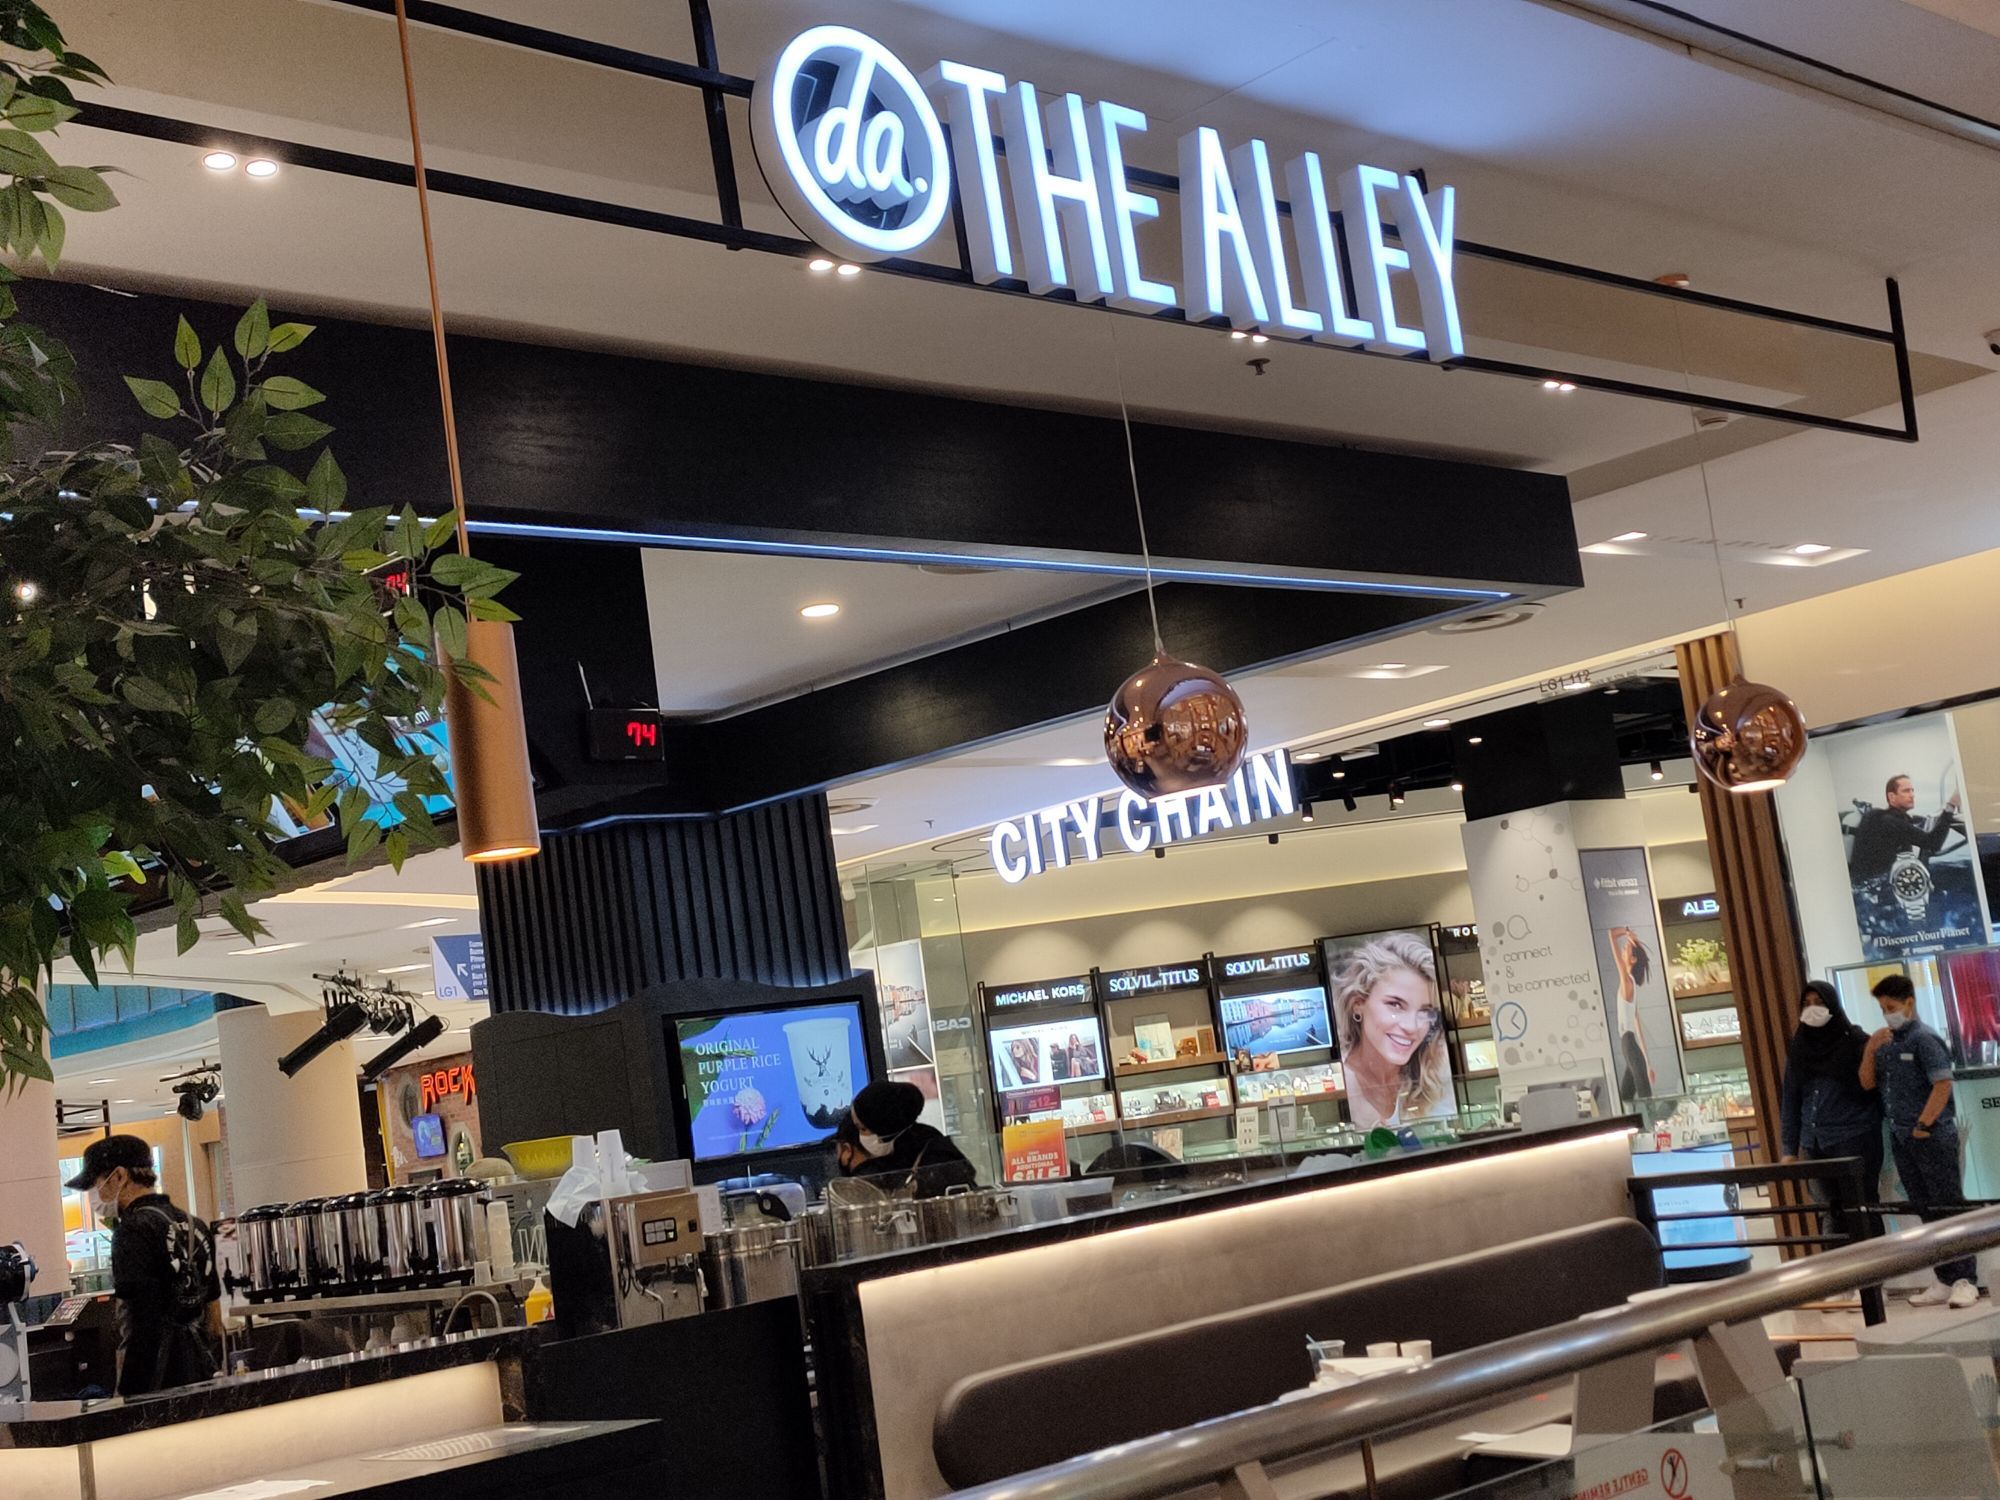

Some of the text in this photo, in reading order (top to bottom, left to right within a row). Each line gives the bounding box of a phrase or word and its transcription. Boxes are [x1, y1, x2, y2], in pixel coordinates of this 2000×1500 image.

[940, 60, 1464, 359] THE ALLEY
[627, 722, 656, 747] 74
[991, 748, 1295, 884] CITY CHAIN
[1683, 899, 1720, 917] ALB
[1273, 953, 1310, 970] TITUS
[1503, 946, 1553, 963] connect
[1160, 968, 1200, 985] TITUS
[1505, 965, 1515, 979] &
[1507, 969, 1591, 994] be connected
[440, 986, 458, 998] LG1
[995, 984, 1085, 1007] MICHAEL KORS
[696, 1037, 760, 1056] ORIGINAL
[698, 1053, 782, 1075] PURPLE RICE
[421, 1065, 475, 1111] ROCK
[701, 1076, 755, 1095] YOGURT
[1026, 1152, 1058, 1163] BRANDS
